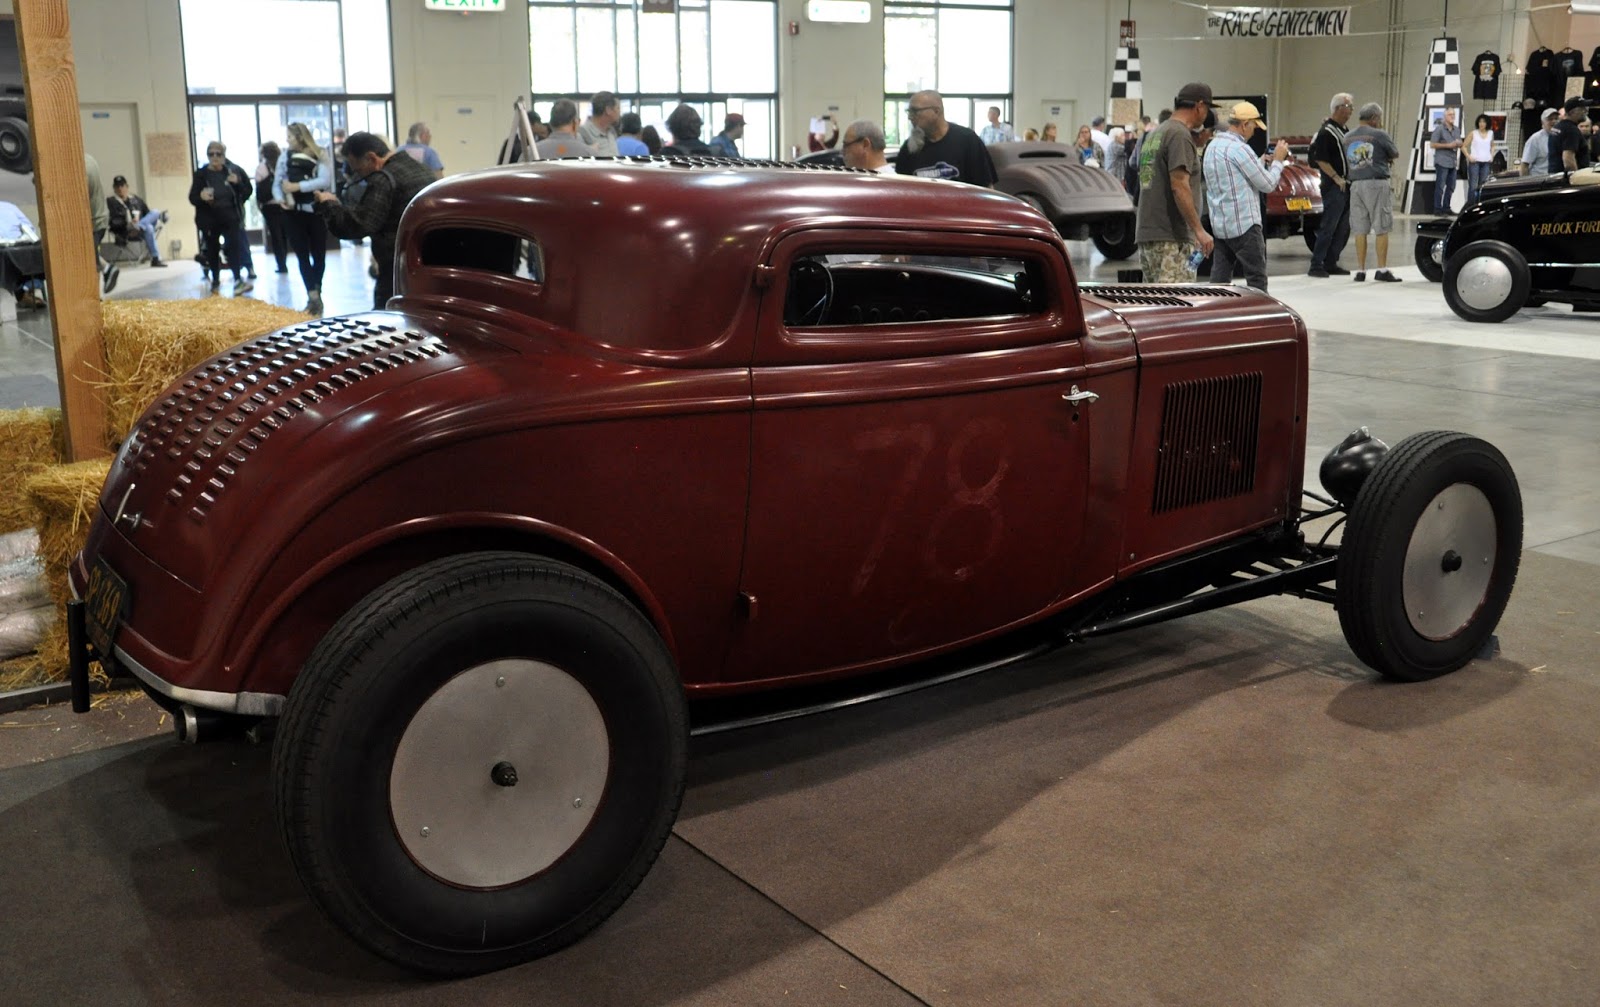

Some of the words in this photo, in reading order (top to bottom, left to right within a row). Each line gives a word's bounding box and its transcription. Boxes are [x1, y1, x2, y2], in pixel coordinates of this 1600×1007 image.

[1208, 17, 1220, 28] THE
[1220, 11, 1260, 37] RACE
[1264, 10, 1348, 37] GENTLEMEN
[1531, 222, 1574, 236] Y-BLOCK
[852, 416, 1011, 596] 78
